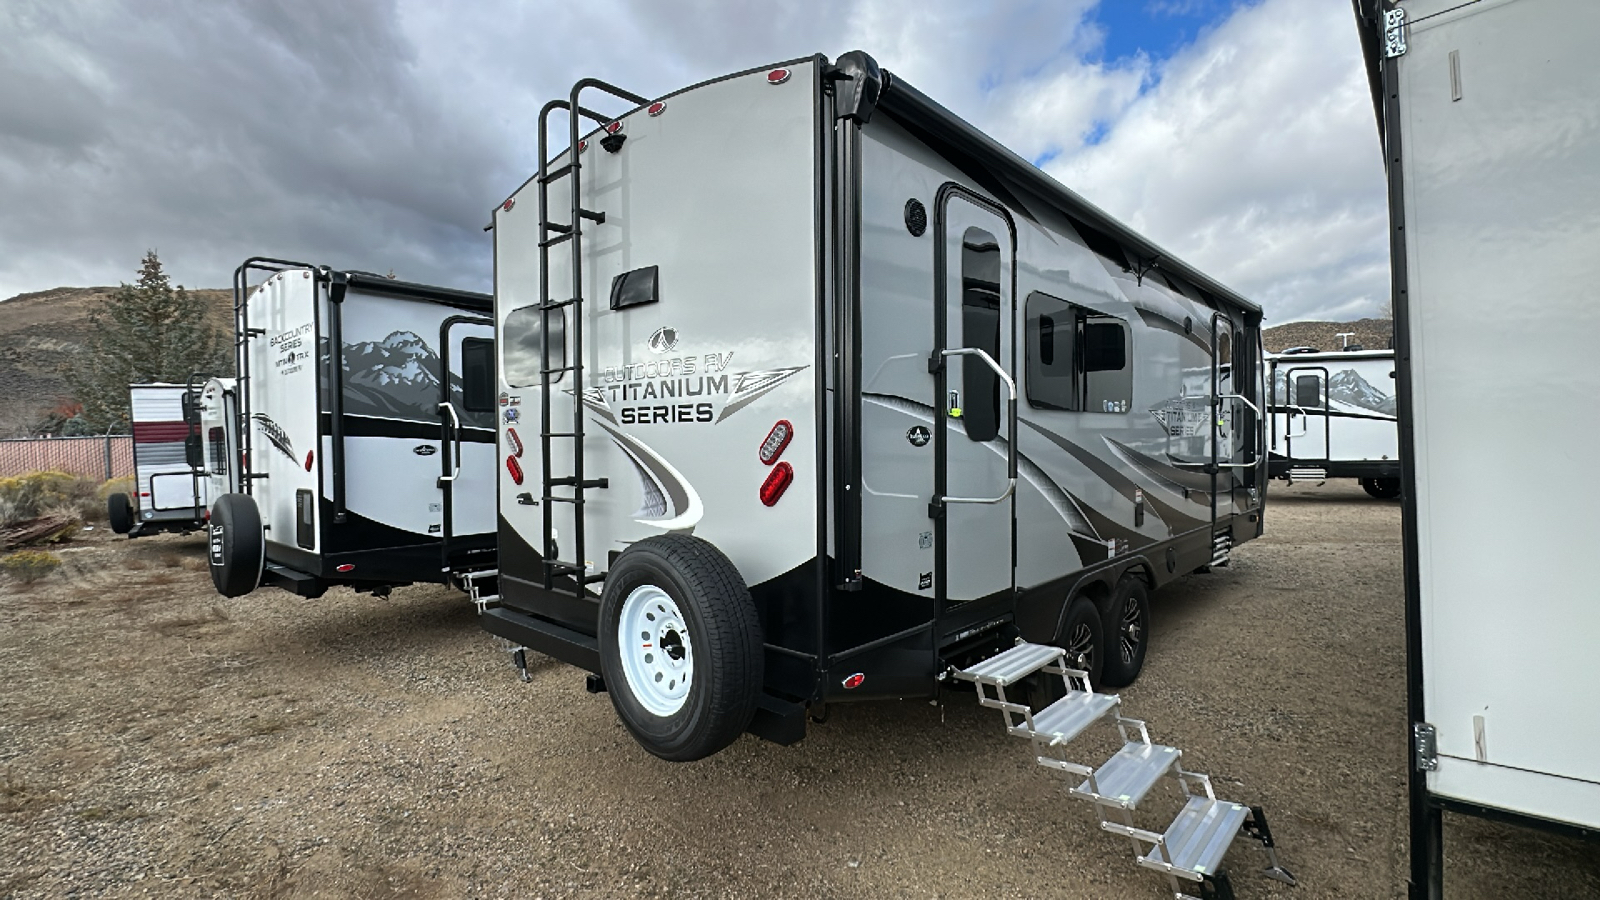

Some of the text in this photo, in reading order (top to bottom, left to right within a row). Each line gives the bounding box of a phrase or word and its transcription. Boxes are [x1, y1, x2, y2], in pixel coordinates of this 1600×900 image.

[270, 321, 314, 347] BACKCOUNTRY
[280, 337, 302, 353] SERIES
[604, 351, 734, 382] OUTDOORS RV
[608, 375, 729, 402] TITANIUM
[621, 403, 714, 424] SERIES
